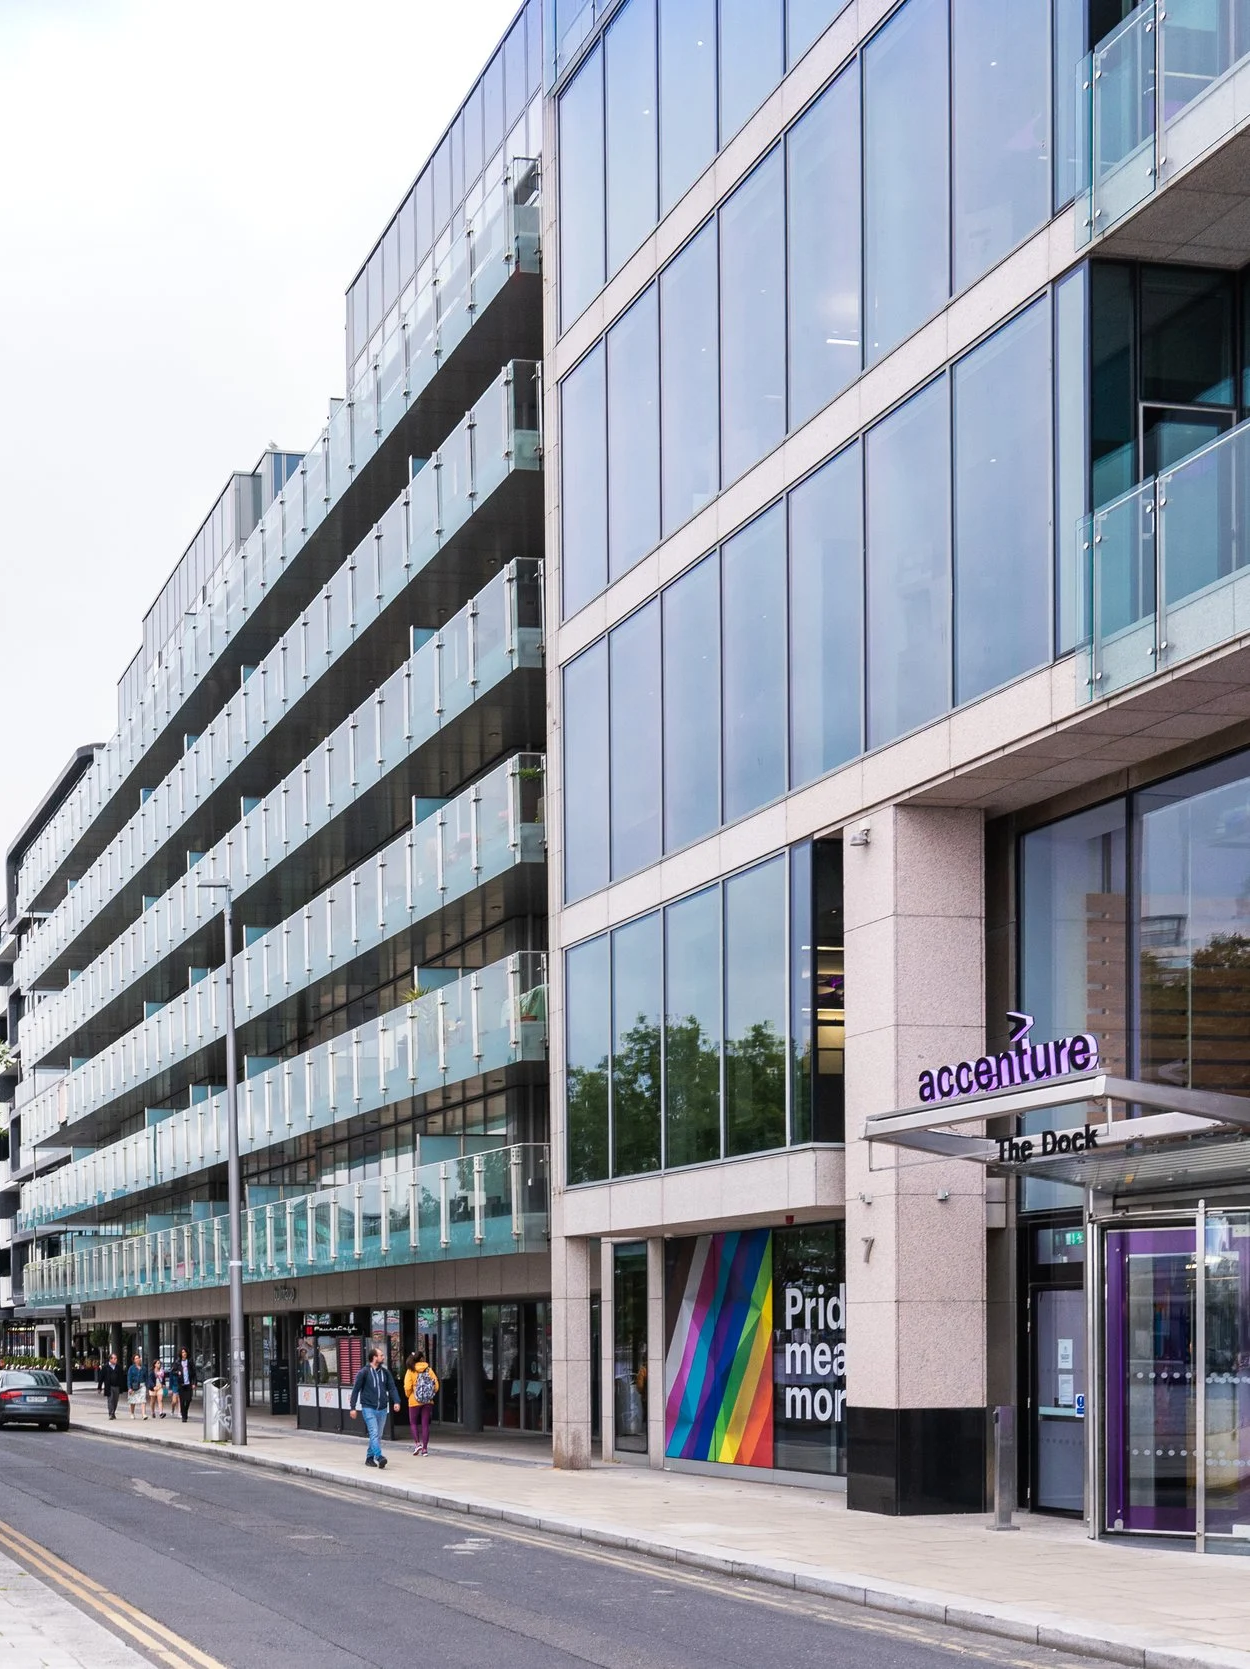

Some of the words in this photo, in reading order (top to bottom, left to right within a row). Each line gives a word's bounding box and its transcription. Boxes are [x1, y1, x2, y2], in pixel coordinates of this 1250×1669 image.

[918, 1034, 1098, 1102] accenture
[995, 1137, 1033, 1163] The
[1042, 1123, 1099, 1156] Dock
[861, 1236, 875, 1264] 7
[785, 1283, 846, 1331] Prid
[785, 1342, 847, 1376] mea
[785, 1386, 847, 1422] mor
